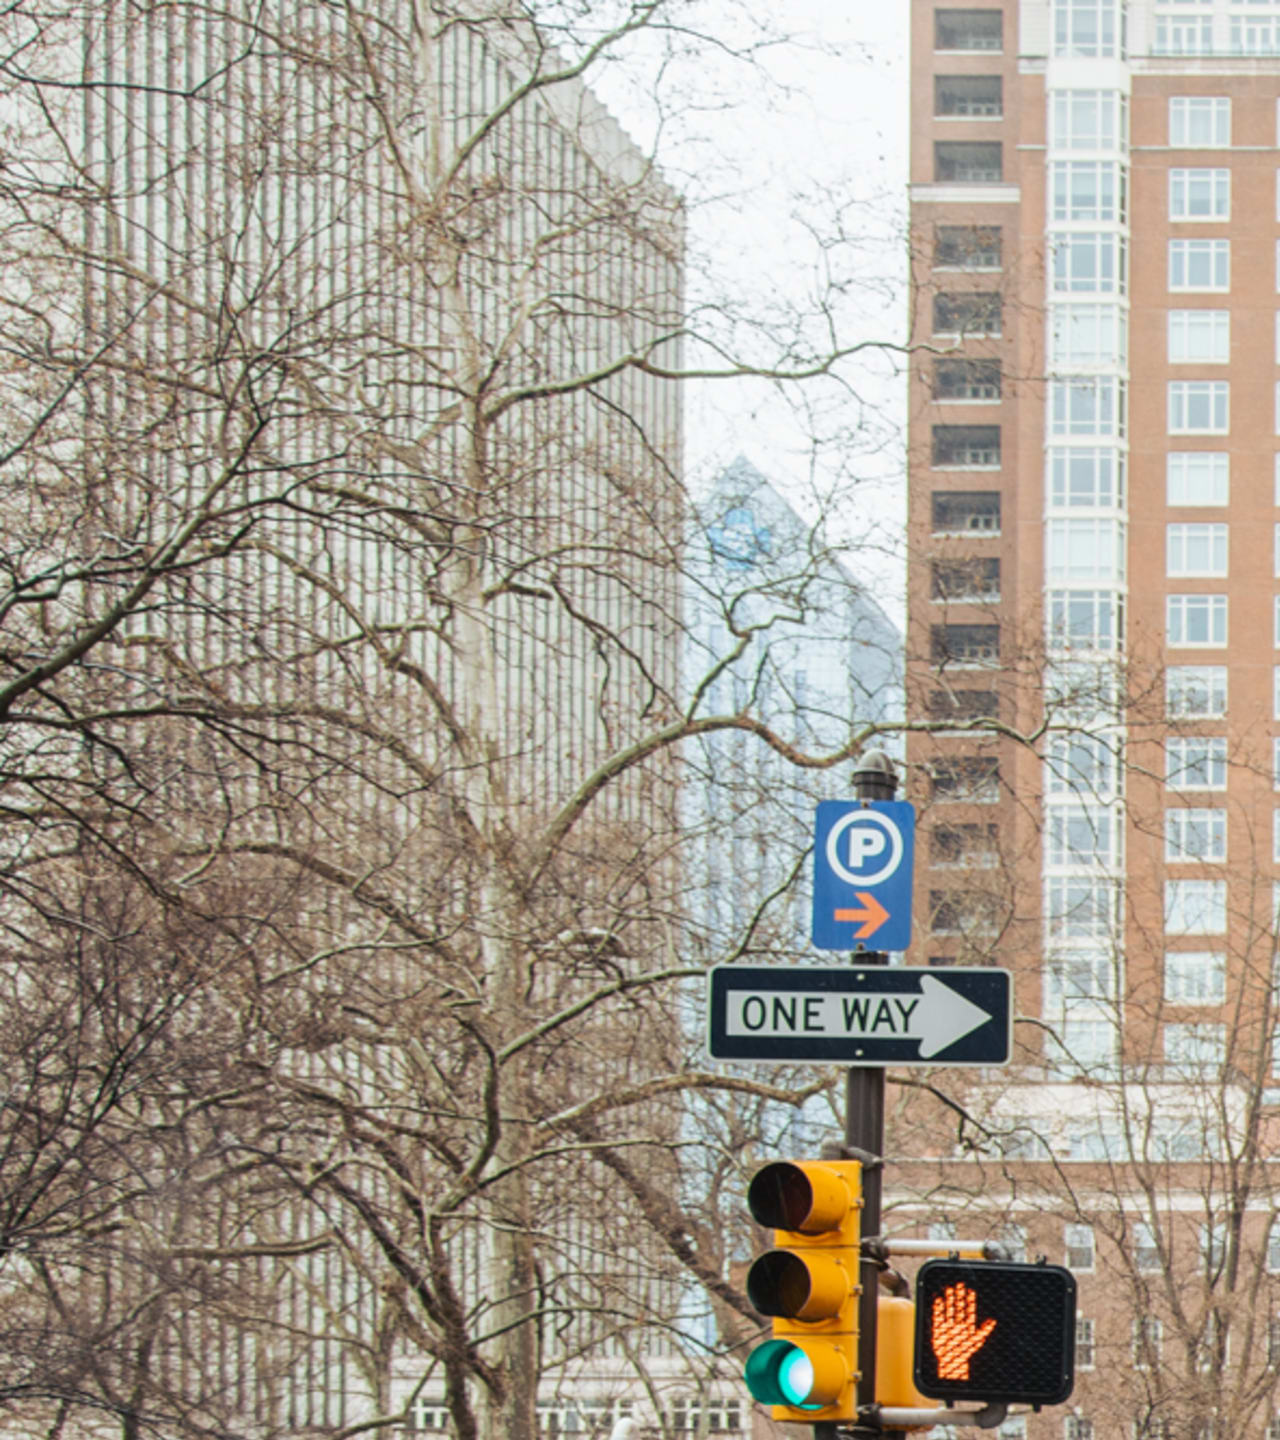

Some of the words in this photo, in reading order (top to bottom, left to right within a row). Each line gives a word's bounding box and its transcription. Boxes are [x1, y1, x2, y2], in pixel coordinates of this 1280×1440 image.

[848, 828, 886, 868] P
[742, 996, 824, 1031] ONE
[842, 997, 919, 1033] WAY
